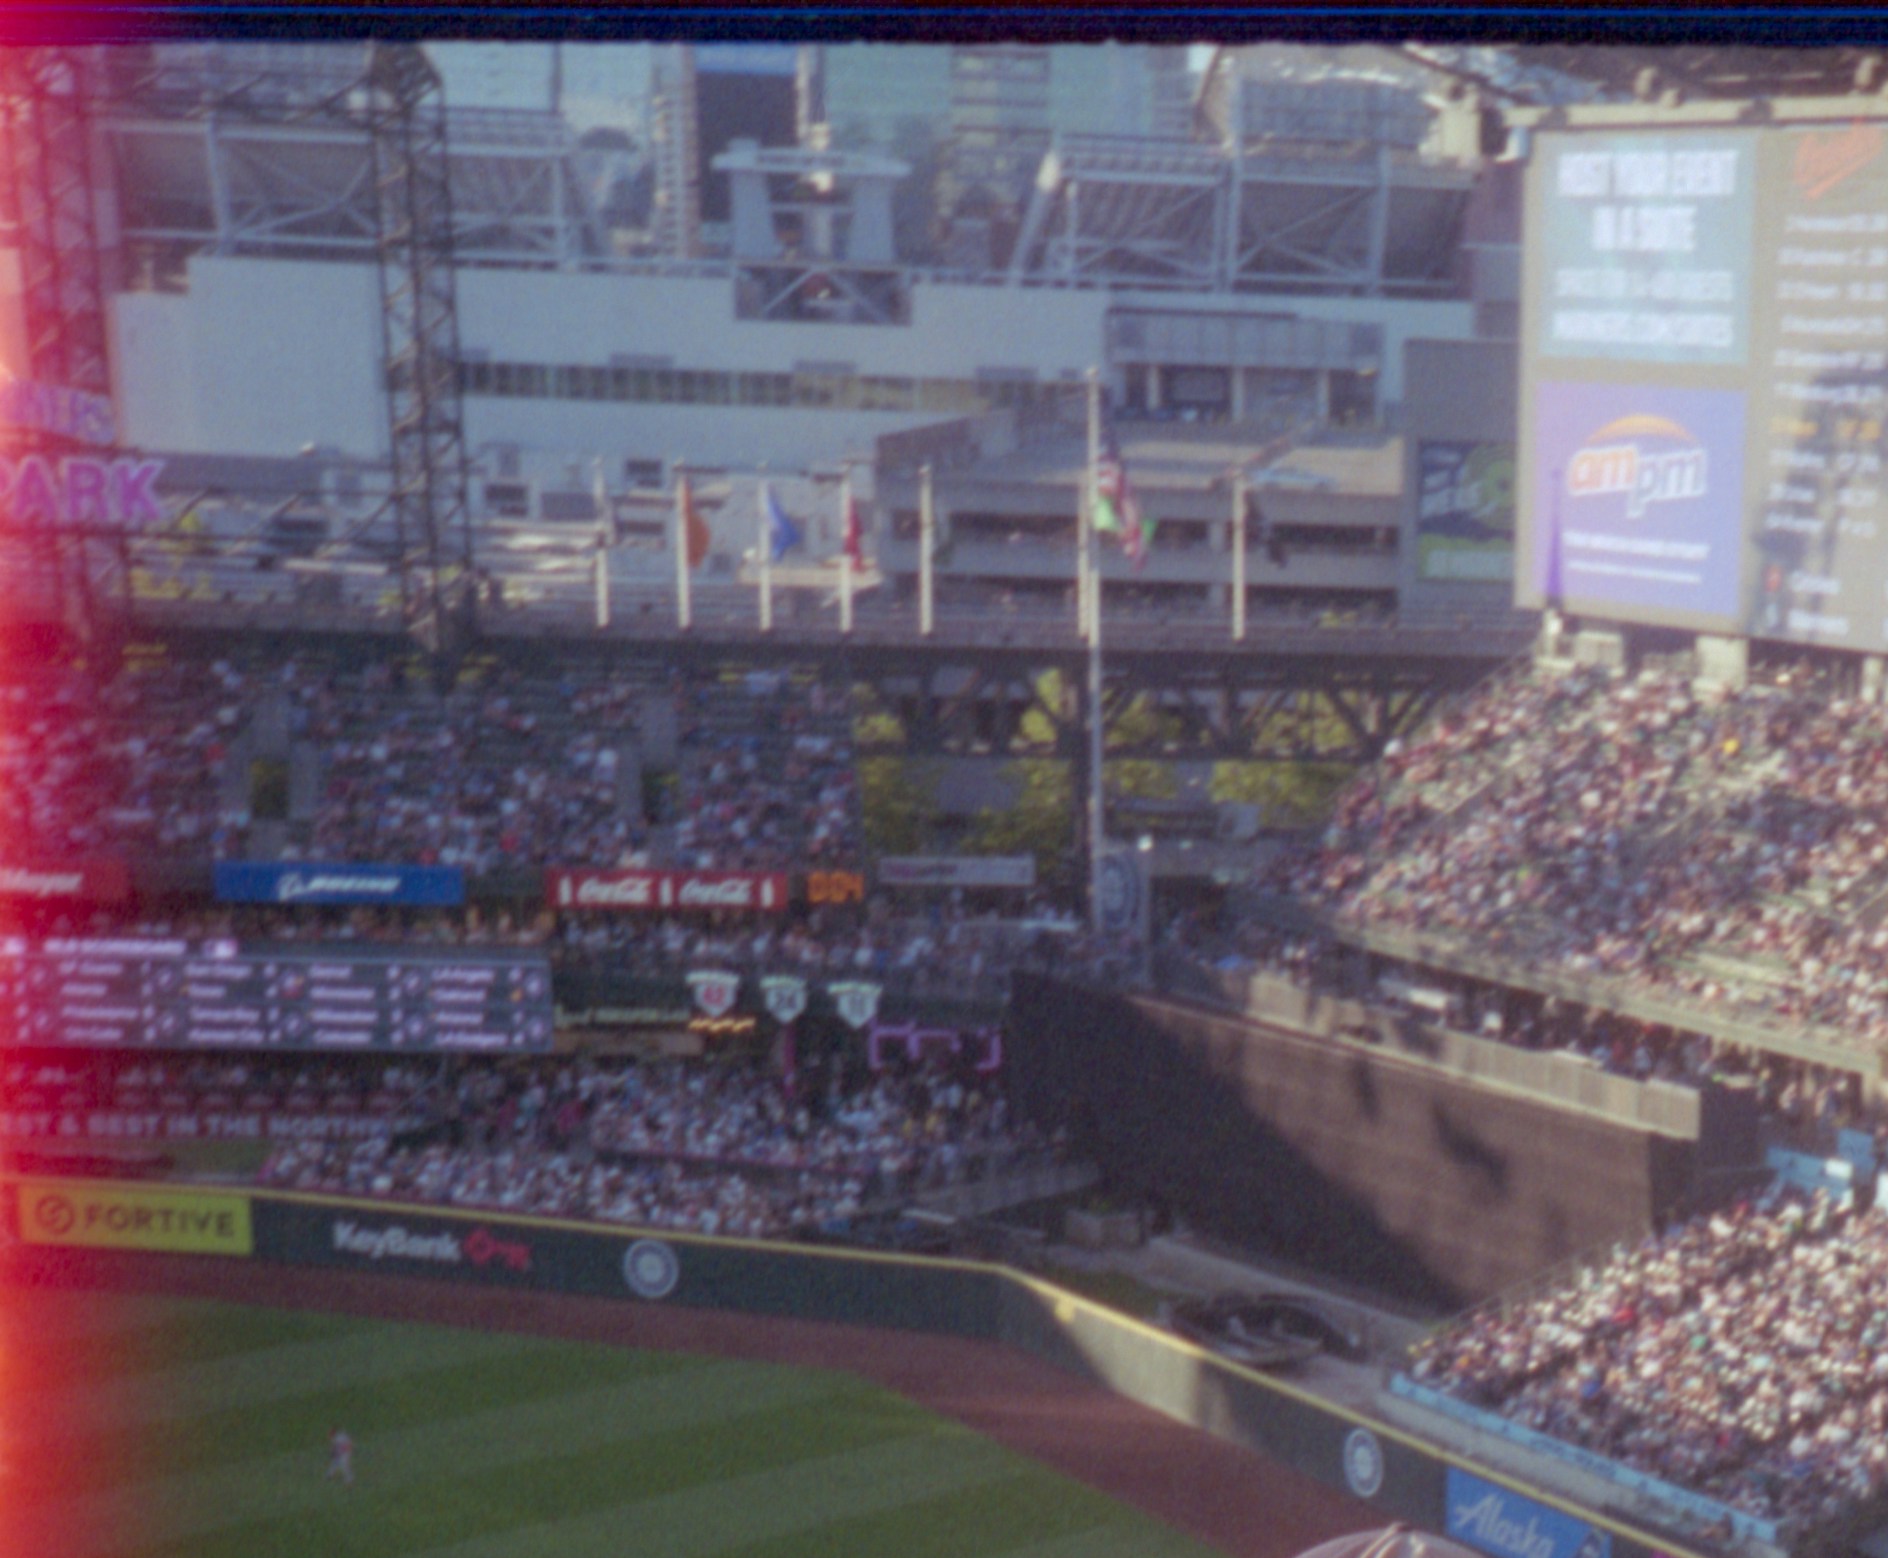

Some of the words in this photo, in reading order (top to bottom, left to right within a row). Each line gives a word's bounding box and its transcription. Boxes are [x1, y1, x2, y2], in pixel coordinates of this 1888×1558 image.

[575, 873, 655, 903] Coca-Cola
[678, 875, 755, 904] Coca-Cola
[86, 1112, 161, 1137] BEST
[204, 1113, 262, 1137] THE
[82, 1205, 236, 1239] FORTIVE
[331, 1218, 462, 1263] KeyBank
